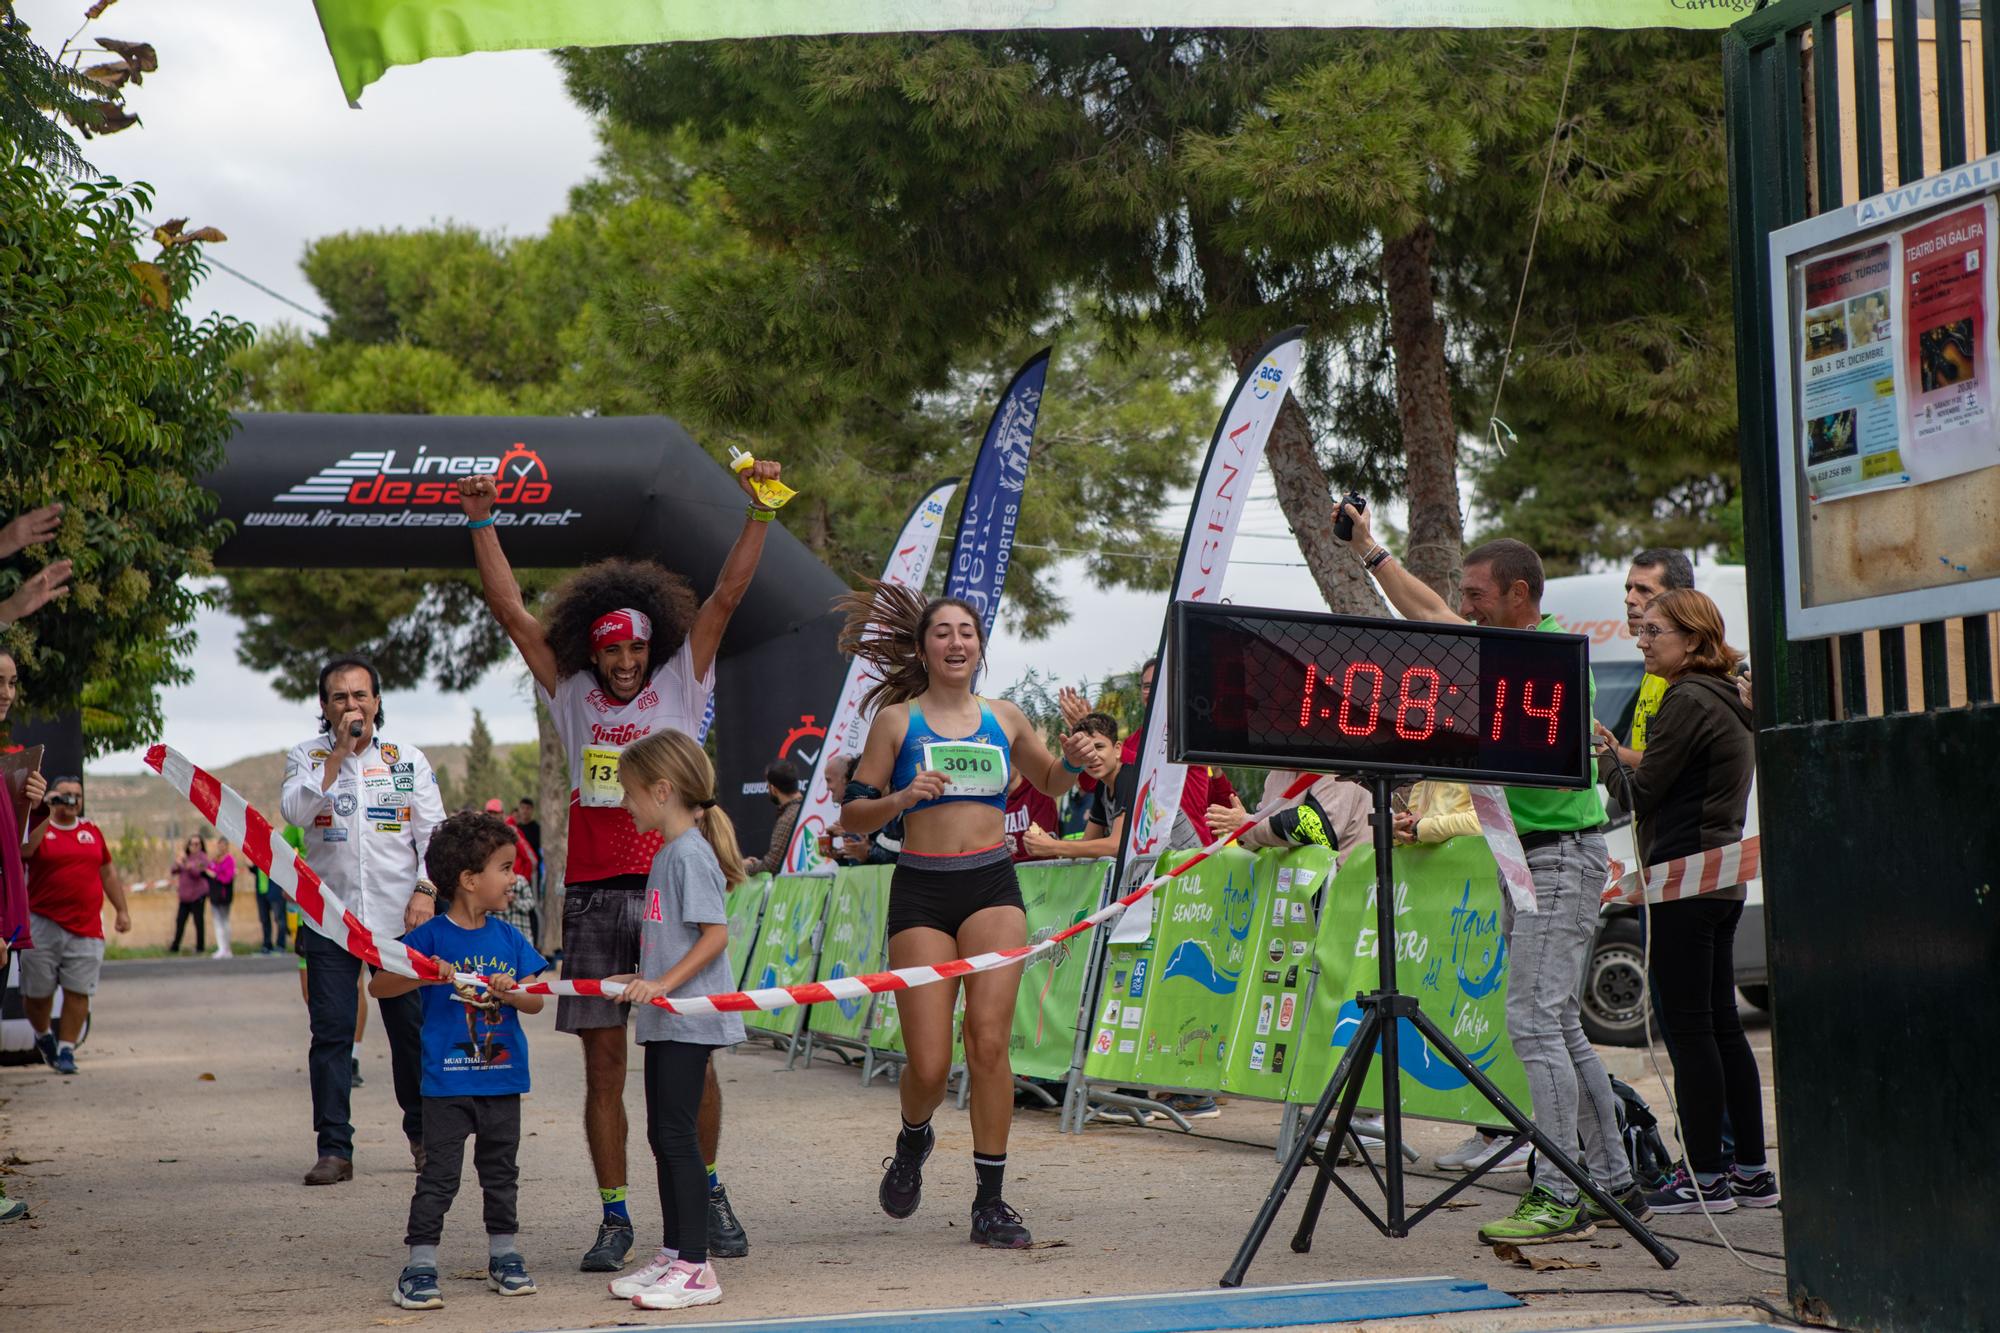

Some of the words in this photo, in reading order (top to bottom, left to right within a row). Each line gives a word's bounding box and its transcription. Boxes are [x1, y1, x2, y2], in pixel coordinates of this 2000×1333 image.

[1906, 240, 1934, 262] TEATRO
[1936, 234, 1947, 251] EN
[1948, 223, 1984, 246] GALIFA
[1811, 365, 1824, 376] DIA
[1836, 358, 1845, 369] DE
[1847, 346, 1884, 366] DICIEMBRE
[347, 475, 412, 504] de
[412, 475, 553, 504] sada
[244, 509, 582, 527] www.lineadesada.net
[992, 503, 1018, 598] DEPORTES
[943, 757, 992, 772] 3010
[1177, 874, 1204, 896] TRAIL
[1172, 903, 1213, 922] SENDERO
[450, 955, 517, 977] HAILAND
[1423, 957, 1442, 991] del
[1453, 1001, 1489, 1044] Galifa
[444, 1057, 462, 1065] MUAY
[464, 1056, 480, 1064] THAI
